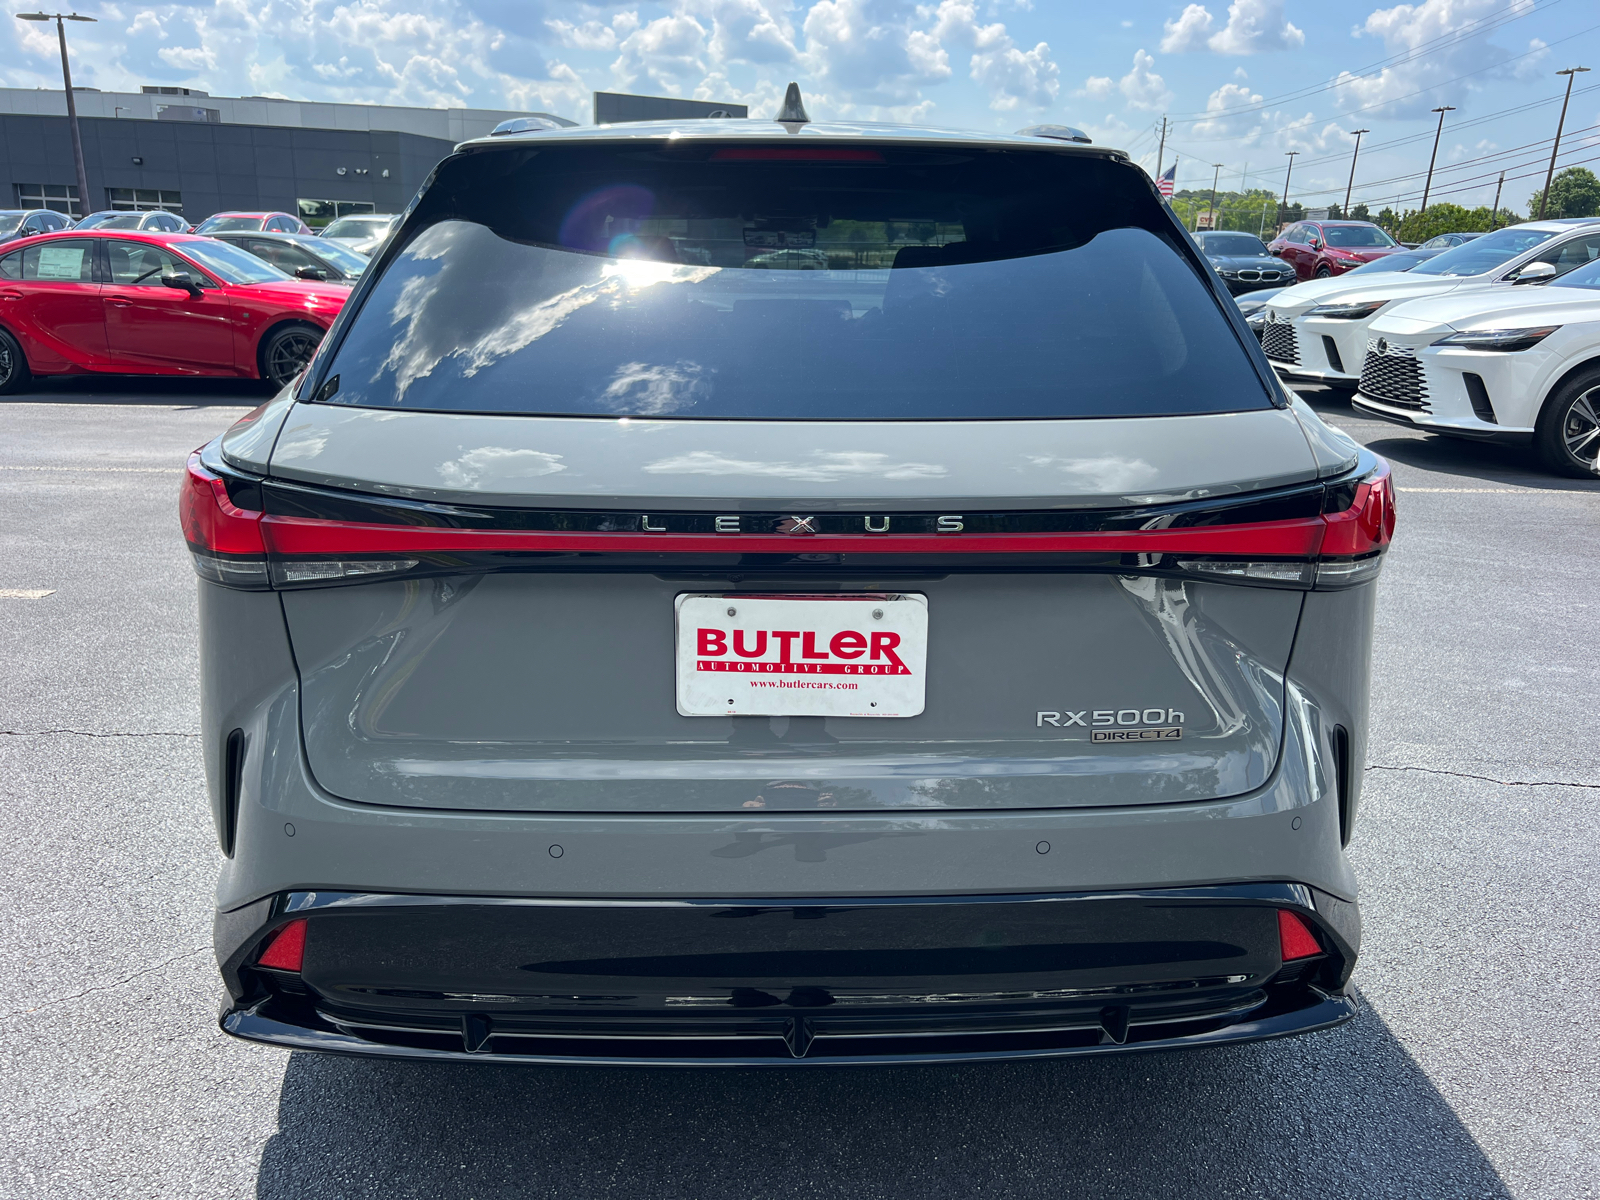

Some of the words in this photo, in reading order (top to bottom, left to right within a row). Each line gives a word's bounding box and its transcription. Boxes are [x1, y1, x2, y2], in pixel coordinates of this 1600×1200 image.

[642, 515, 964, 532] LEXUS
[697, 662, 823, 673] AUTOMOTIVE
[844, 664, 905, 675] GROUP
[750, 679, 858, 690] www.butlercars.com
[1094, 728, 1181, 741] DIRECT4
